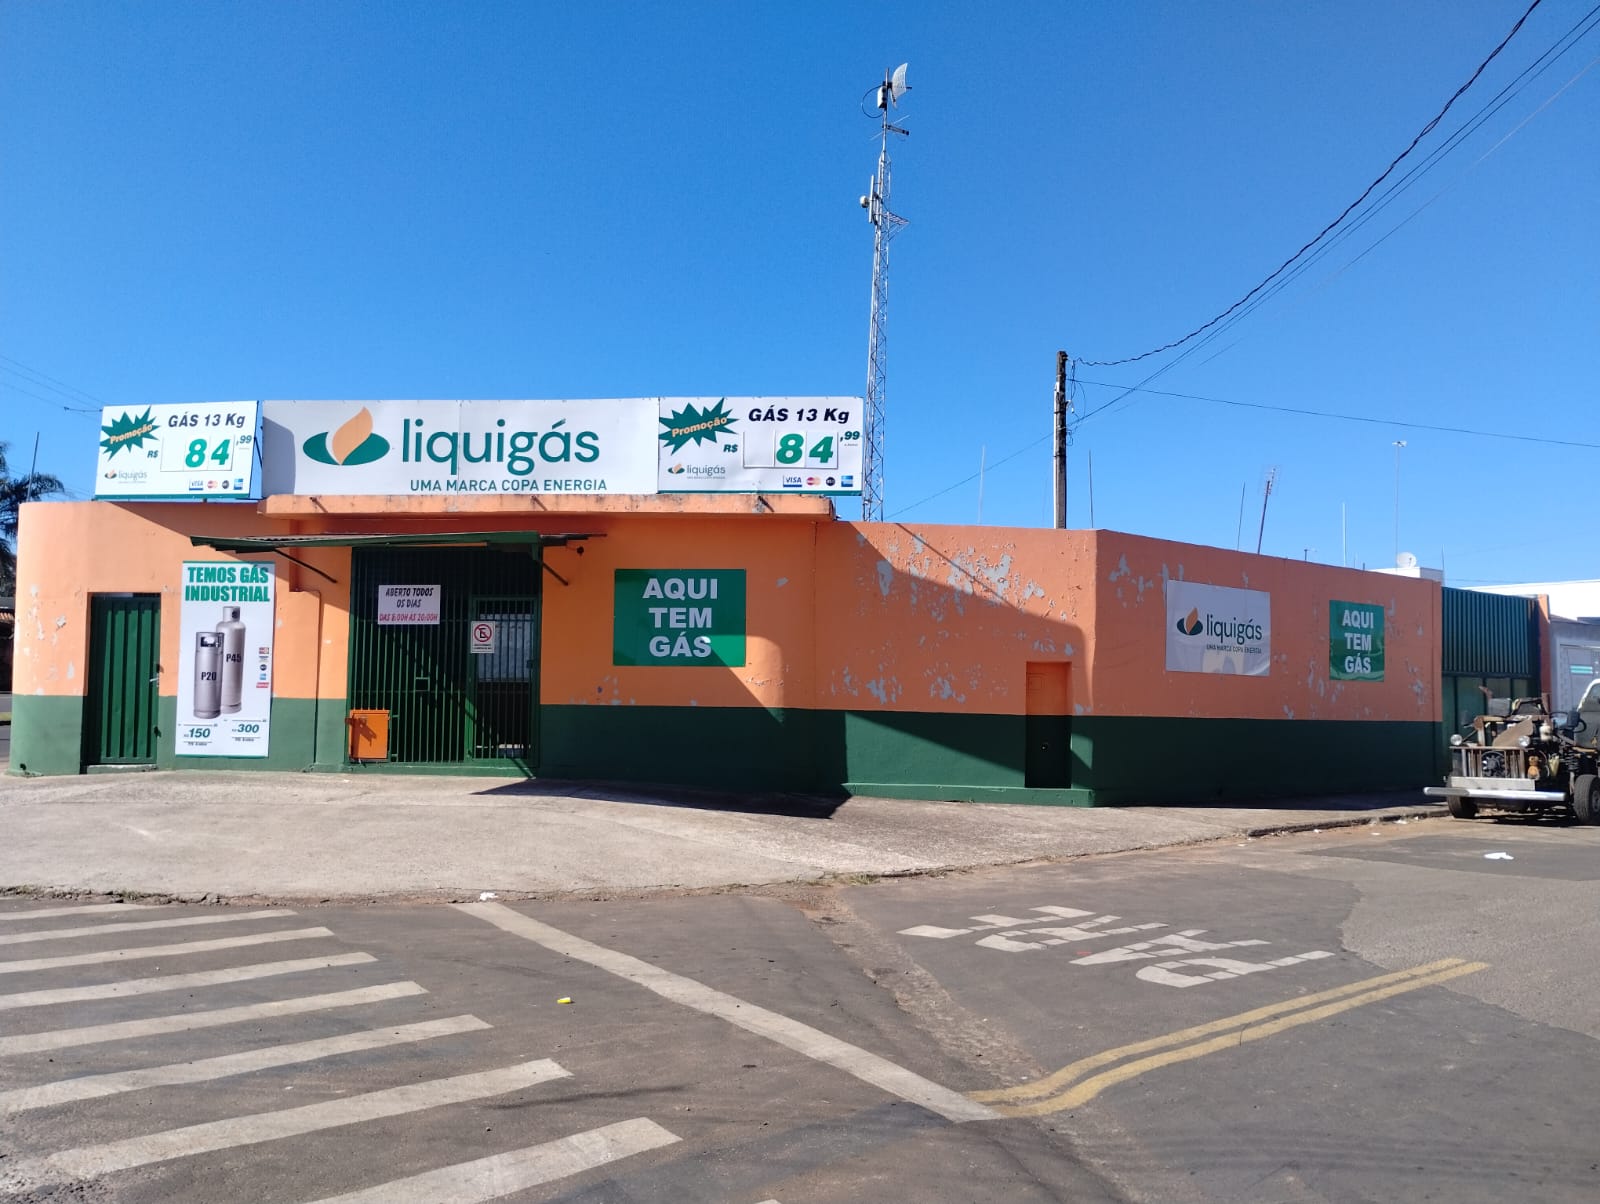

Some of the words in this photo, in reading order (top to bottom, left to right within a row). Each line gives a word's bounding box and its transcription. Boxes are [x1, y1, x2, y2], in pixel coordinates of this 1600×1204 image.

[168, 411, 199, 428] GÁS
[204, 413, 221, 427] 13
[225, 412, 246, 429] Kg
[749, 405, 788, 422] GÁS
[796, 408, 818, 422] 13
[823, 408, 850, 424] Kg
[108, 422, 153, 445] Promoção
[671, 415, 728, 438] Promoção
[146, 449, 159, 459] R$
[185, 438, 231, 468] 84
[402, 418, 601, 476] liquigás
[723, 444, 738, 453] R$
[776, 433, 834, 465] 84
[686, 464, 726, 477] liquigás
[785, 476, 802, 484] VISA
[410, 479, 443, 492] UMA
[446, 479, 498, 492] MARCA
[501, 479, 540, 492] COPA
[543, 479, 608, 491] ENERGIA
[187, 566, 237, 584] TEMOS
[239, 564, 270, 584] GÁS
[184, 585, 271, 602] INDUSTRIAL
[385, 587, 411, 597] ABERTO
[412, 587, 434, 597] TODOS
[642, 577, 719, 601] AQUI
[396, 599, 406, 608] OS
[406, 599, 422, 608] DIAS
[648, 607, 713, 629] TEM
[1342, 609, 1374, 630] AQUI
[1206, 613, 1263, 646] liquigás
[649, 631, 712, 658] GÁS
[1344, 632, 1372, 652] TEM
[226, 653, 242, 663] P45
[1344, 652, 1372, 674] GÁS
[201, 671, 217, 681] P20
[189, 727, 211, 738] 150
[237, 723, 260, 734] 300
